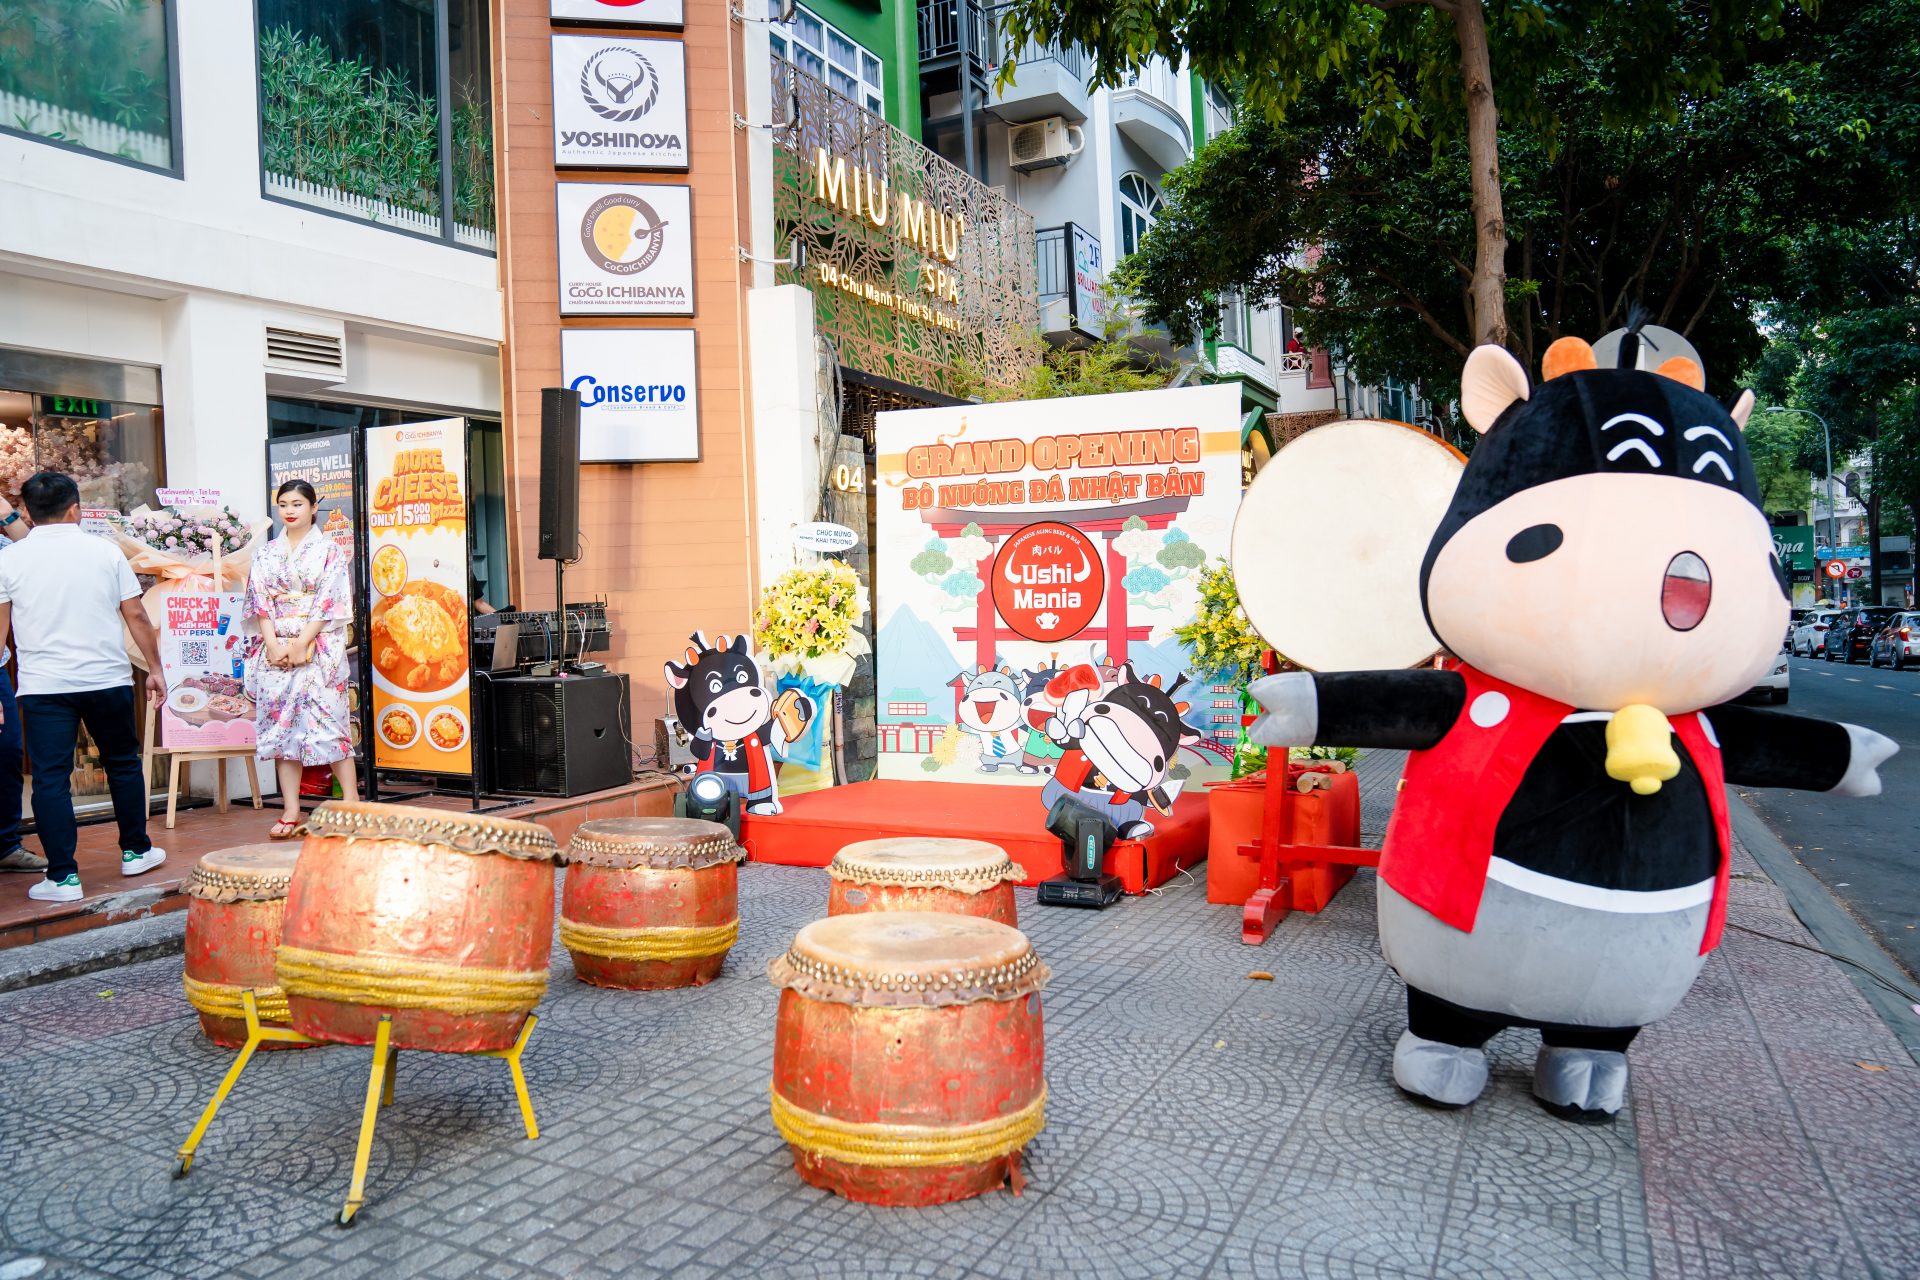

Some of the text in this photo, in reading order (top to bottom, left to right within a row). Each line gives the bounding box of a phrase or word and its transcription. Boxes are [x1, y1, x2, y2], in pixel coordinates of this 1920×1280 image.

[561, 131, 682, 149] YOSHINOYA
[818, 148, 887, 227] MIU
[903, 192, 957, 262] MIU
[584, 219, 593, 238] Good
[604, 196, 622, 206] Good
[623, 197, 641, 208] curry
[1089, 243, 1100, 268] 2F
[821, 263, 837, 287] 04
[841, 274, 862, 296] Chu
[926, 264, 960, 305] SPA
[569, 286, 685, 298] CoCo ICHIBANYA
[570, 375, 686, 408] Conservo
[54, 396, 97, 415] EXIT
[299, 440, 331, 451] YOSHINOYA
[907, 427, 1200, 479] GRAND OPENING
[271, 453, 352, 471] TREAT YOURSELF WELL
[393, 448, 445, 477] MORE
[836, 464, 864, 492] 04
[903, 467, 1205, 510] BÒ NƯỚNG ĐÁ NHẬT BẢN
[374, 471, 464, 511] CHEESE
[370, 513, 397, 527] ONLY
[1013, 530, 1035, 548] JAPANESE
[1052, 529, 1066, 537] BEEF
[1070, 535, 1081, 546] BAR
[1032, 544, 1063, 556] 肉バル
[1020, 563, 1072, 585] Ushi
[167, 596, 220, 609] CHECK-IN
[1013, 587, 1082, 609] Mania
